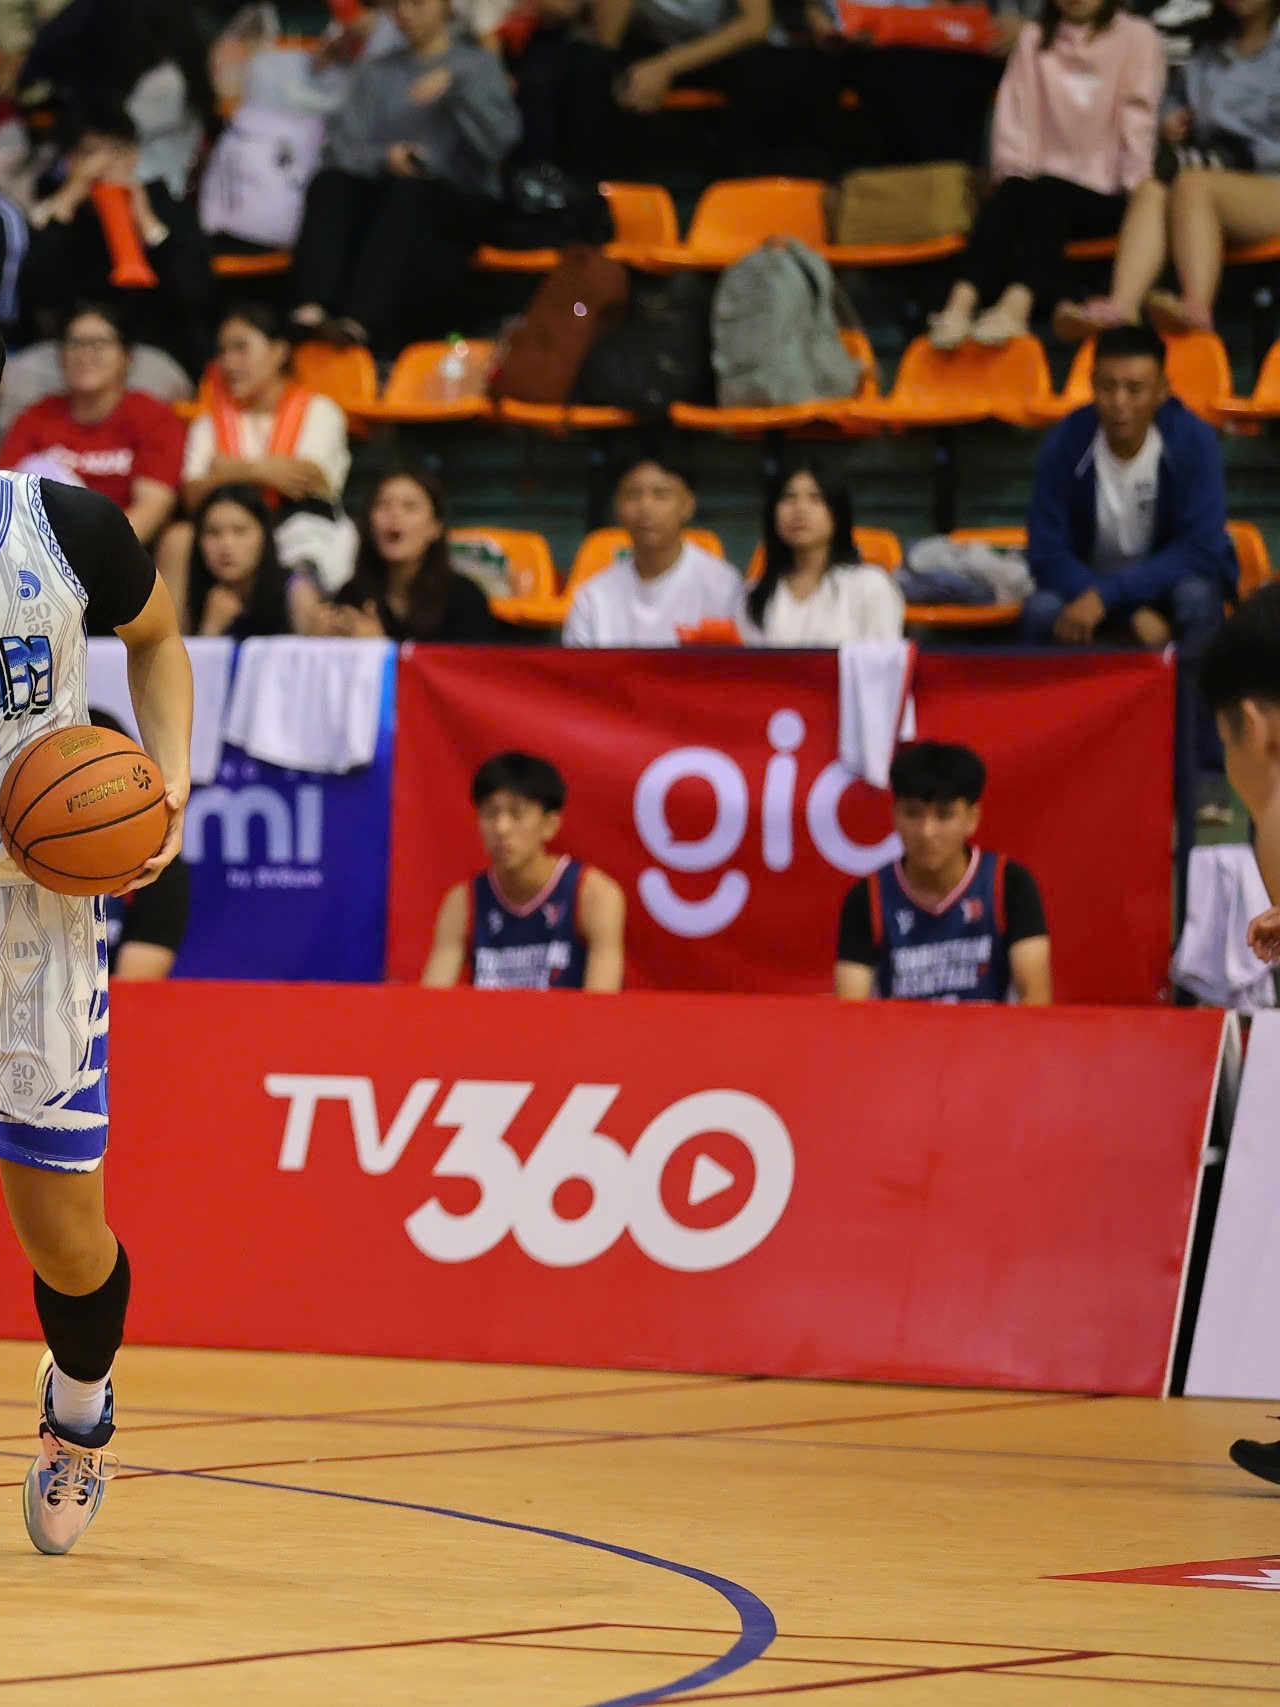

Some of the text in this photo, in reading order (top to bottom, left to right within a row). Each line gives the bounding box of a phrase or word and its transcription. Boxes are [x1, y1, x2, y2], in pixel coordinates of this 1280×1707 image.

[21, 602, 51, 623] 20
[11, 1061, 36, 1081] 20
[12, 1078, 35, 1098] 25
[263, 1072, 796, 1273] TV360
